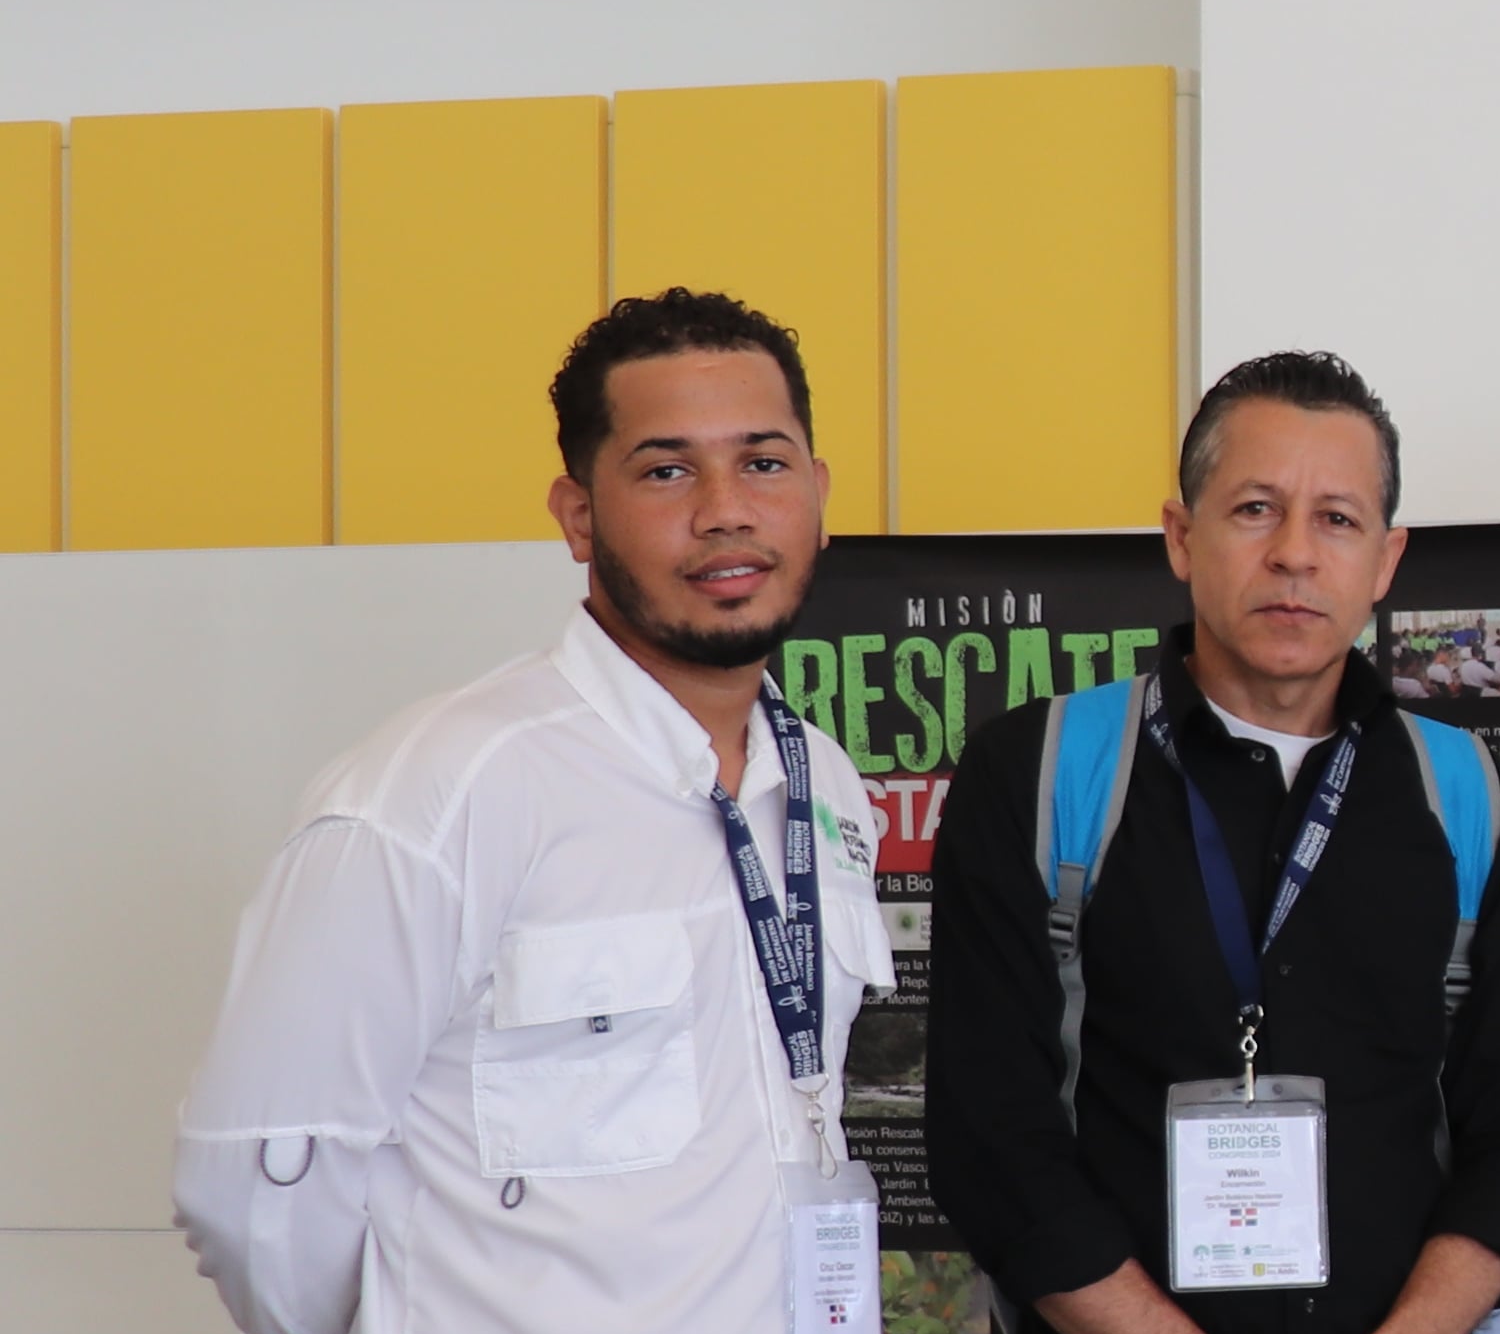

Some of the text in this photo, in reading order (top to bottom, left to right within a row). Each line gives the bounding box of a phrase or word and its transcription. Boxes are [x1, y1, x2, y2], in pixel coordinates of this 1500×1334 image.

[1207, 1122, 1280, 1136] BOTANICAL
[1207, 1135, 1282, 1151] BRIDGES
[816, 1225, 861, 1242] BRIDGES
